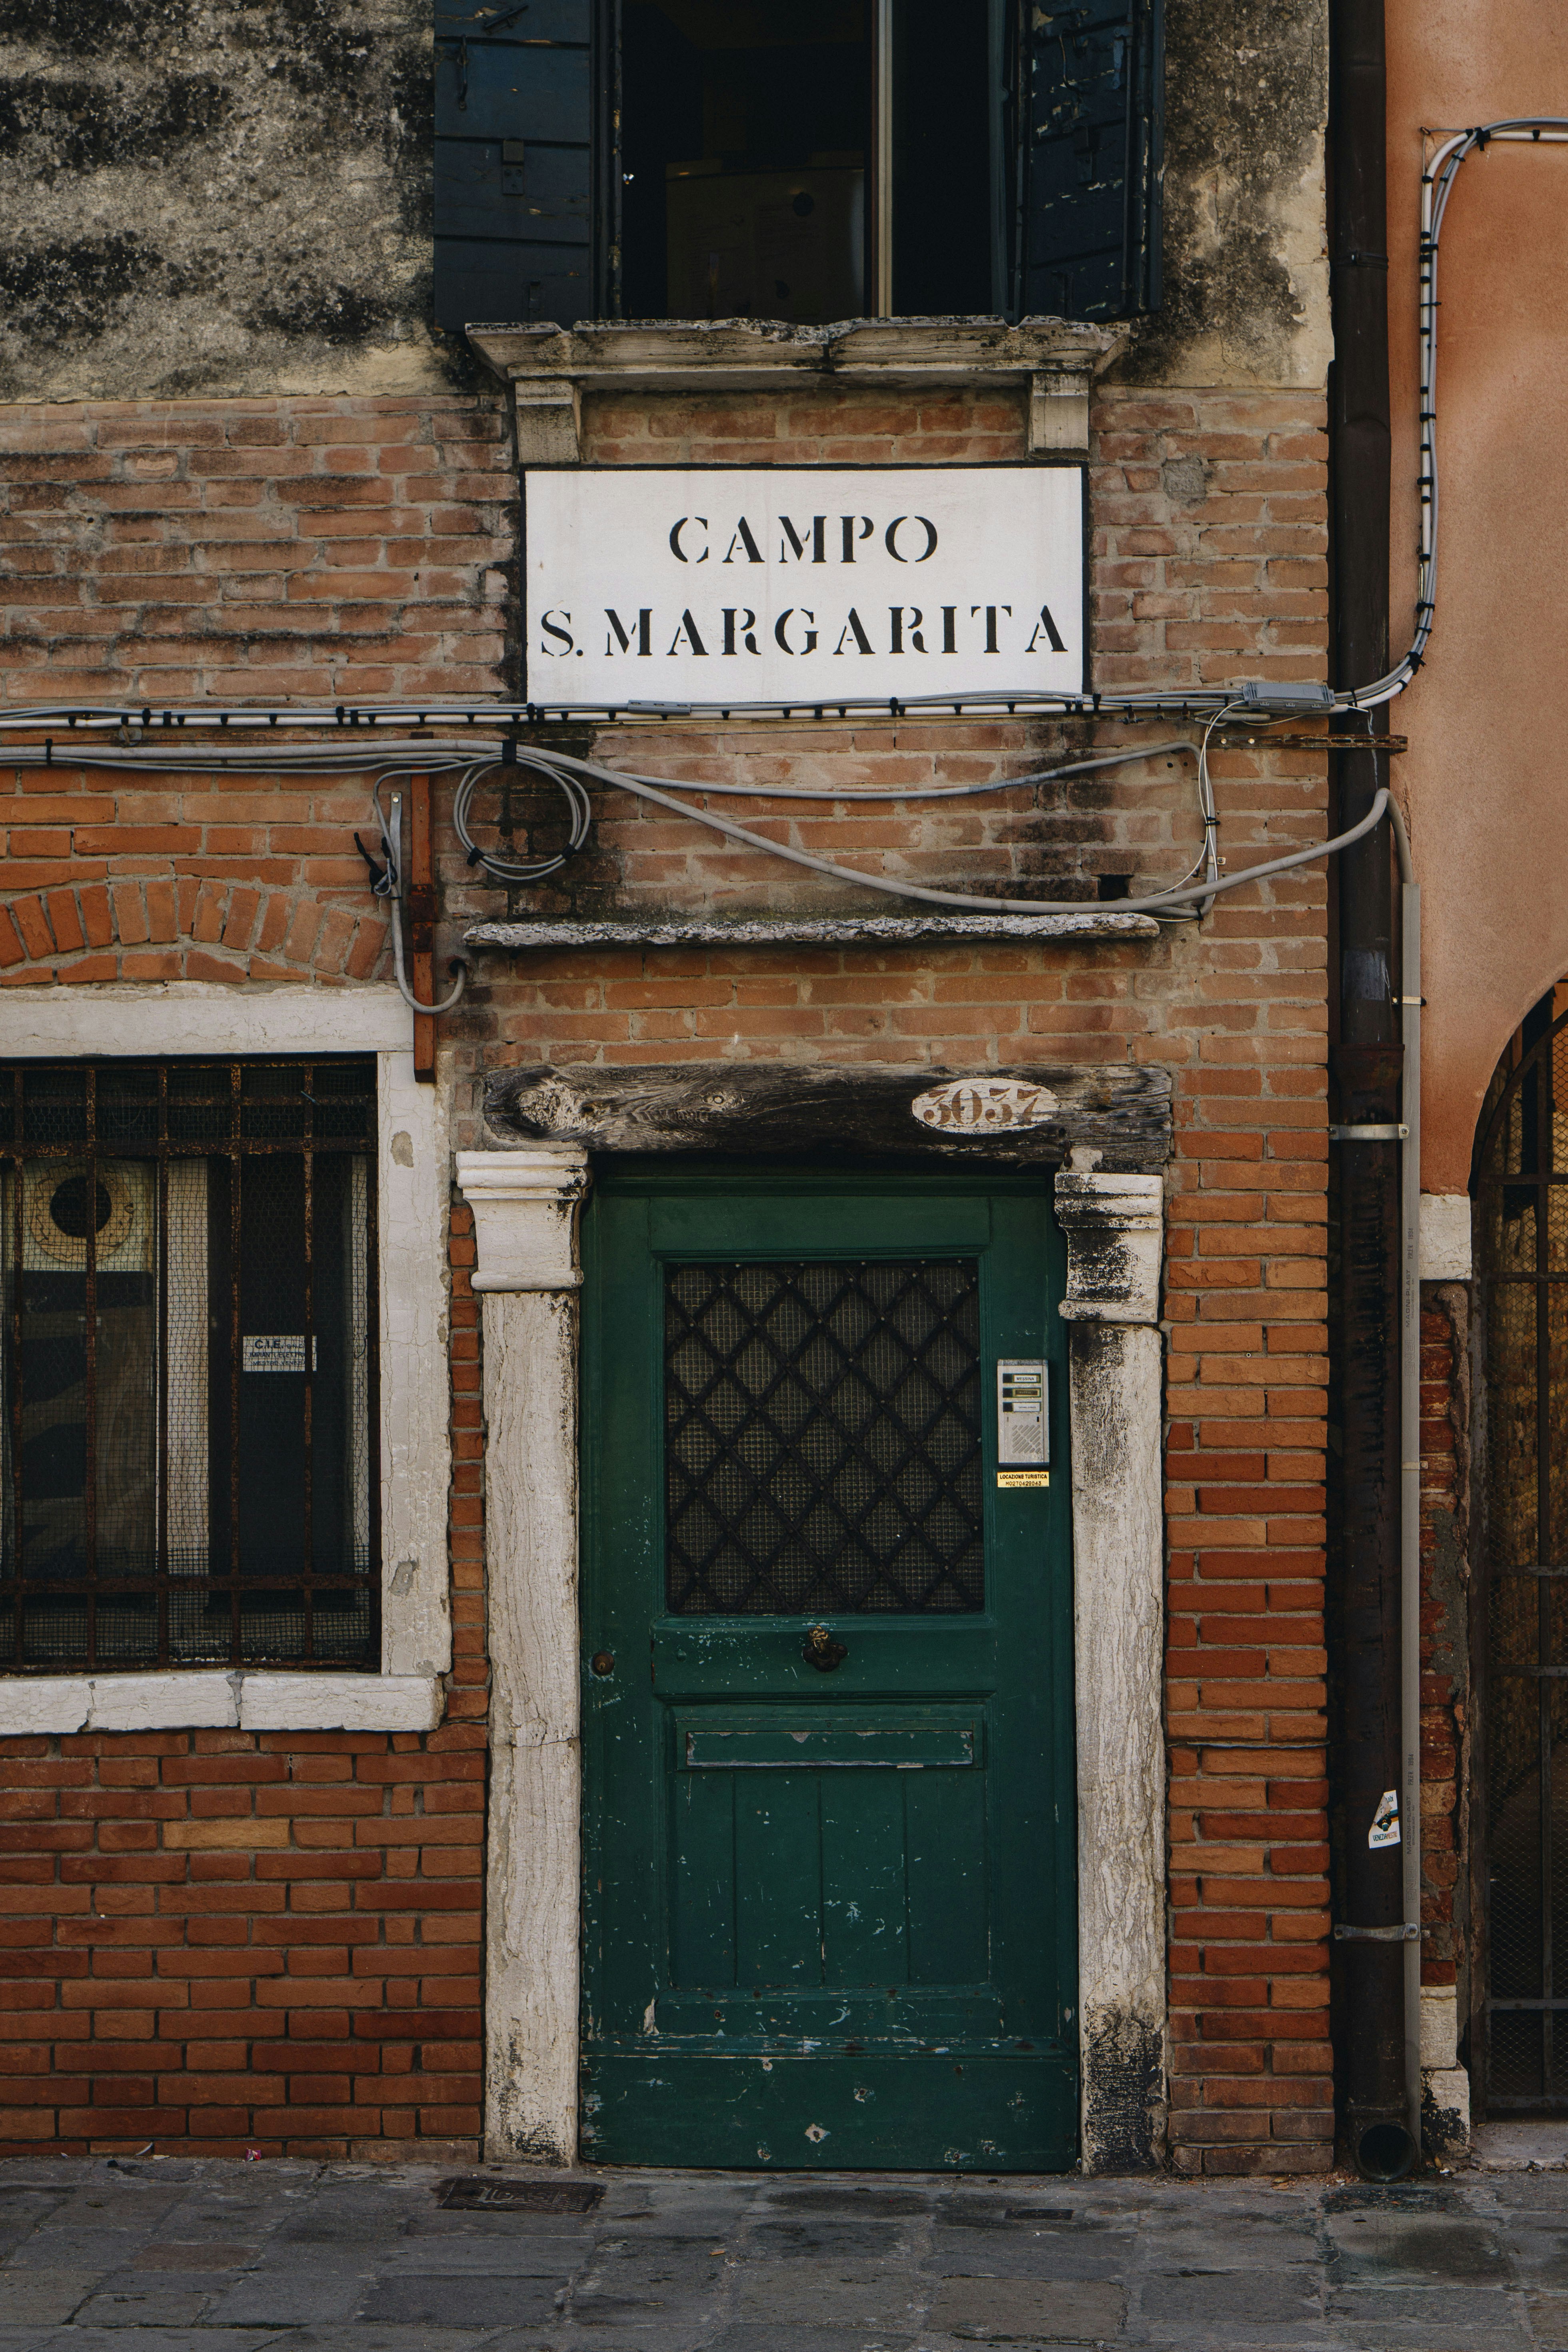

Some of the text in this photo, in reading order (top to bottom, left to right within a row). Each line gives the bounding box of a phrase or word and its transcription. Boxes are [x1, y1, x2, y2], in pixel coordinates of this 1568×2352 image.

[669, 515, 939, 564] CAMPO
[604, 605, 1069, 656] MARGARITA
[923, 1087, 1041, 1126] 3037
